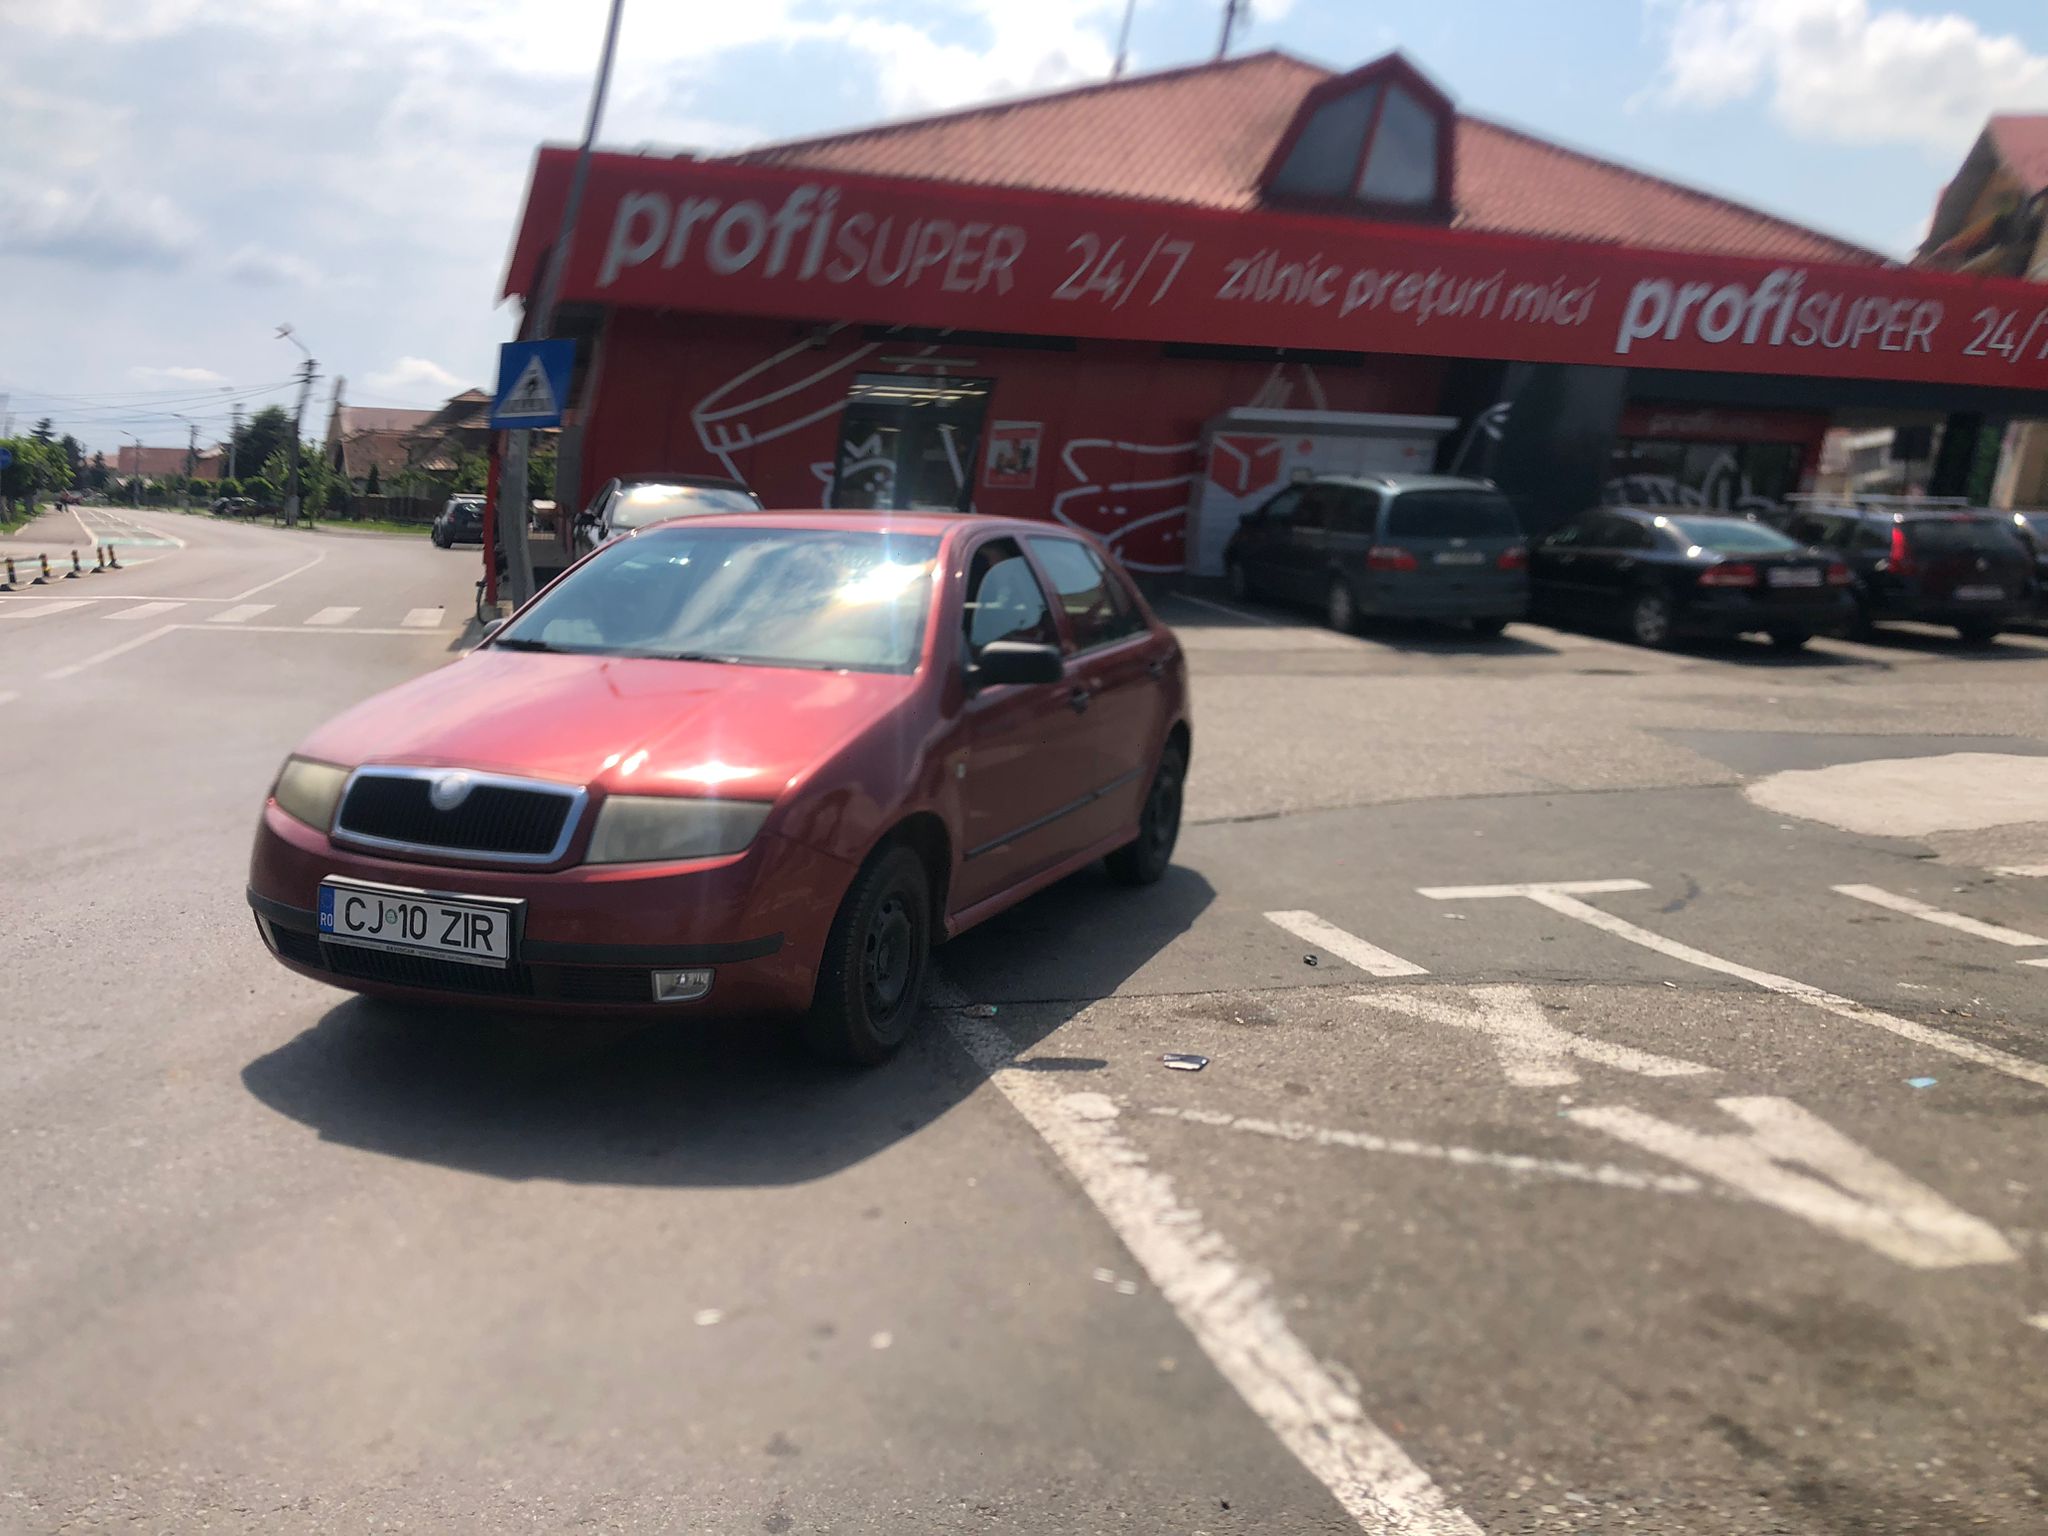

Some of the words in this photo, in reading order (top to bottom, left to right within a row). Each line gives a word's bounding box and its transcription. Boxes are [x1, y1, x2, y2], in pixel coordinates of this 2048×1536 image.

[1050, 230, 1195, 311] 24/7
[319, 911, 334, 928] RO
[344, 896, 384, 934] CJ
[397, 903, 428, 941] 10
[440, 909, 494, 952] ZIR
